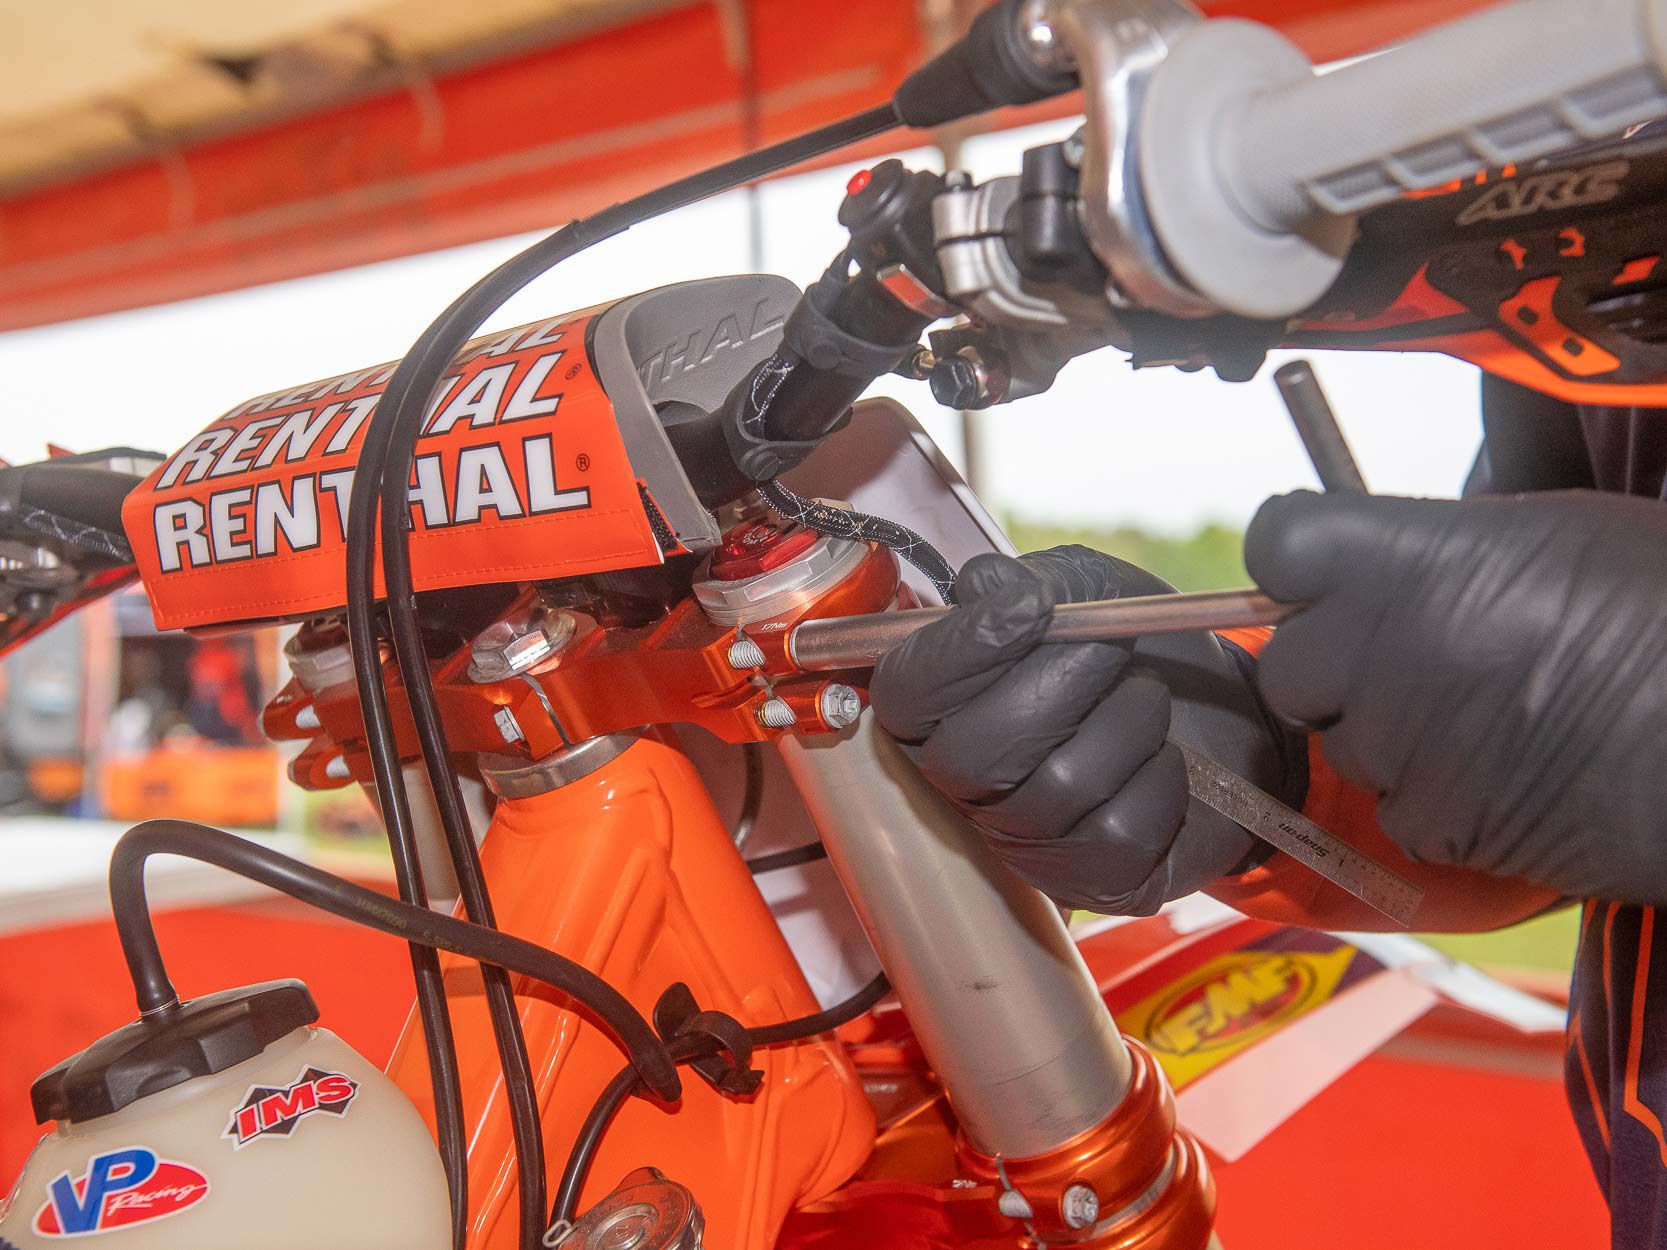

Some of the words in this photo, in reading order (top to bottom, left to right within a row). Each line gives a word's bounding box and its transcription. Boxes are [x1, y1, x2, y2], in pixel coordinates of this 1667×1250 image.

[1278, 822, 1331, 859] Snap-on
[1150, 955, 1296, 1055] FMF
[234, 1074, 356, 1146] IMS
[50, 1148, 158, 1234] VP
[106, 1182, 209, 1216] Racing
